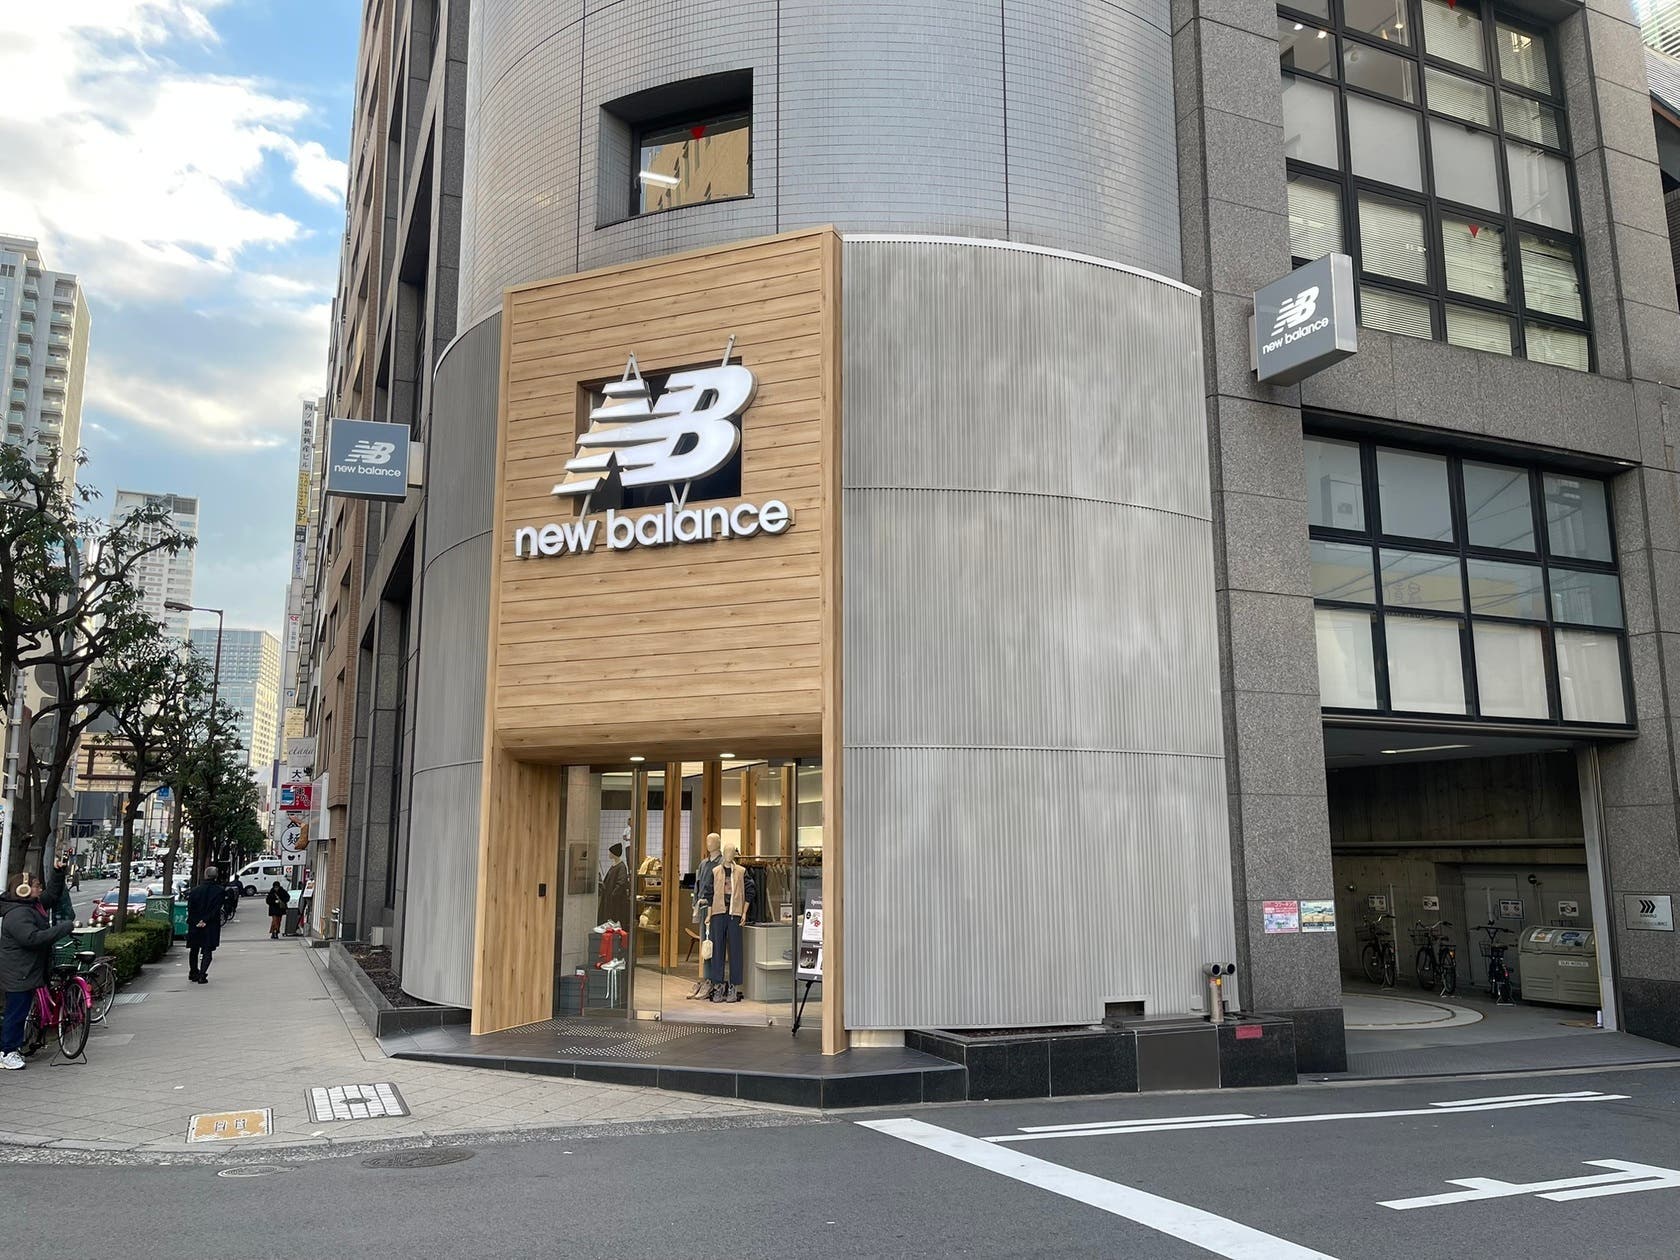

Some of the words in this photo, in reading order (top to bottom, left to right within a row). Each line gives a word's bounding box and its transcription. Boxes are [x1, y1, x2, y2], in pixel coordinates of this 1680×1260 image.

[1262, 337, 1283, 355] new
[1285, 317, 1329, 345] balance
[334, 464, 356, 473] new
[358, 465, 401, 478] balance
[514, 518, 600, 559] new
[606, 499, 793, 551] balance
